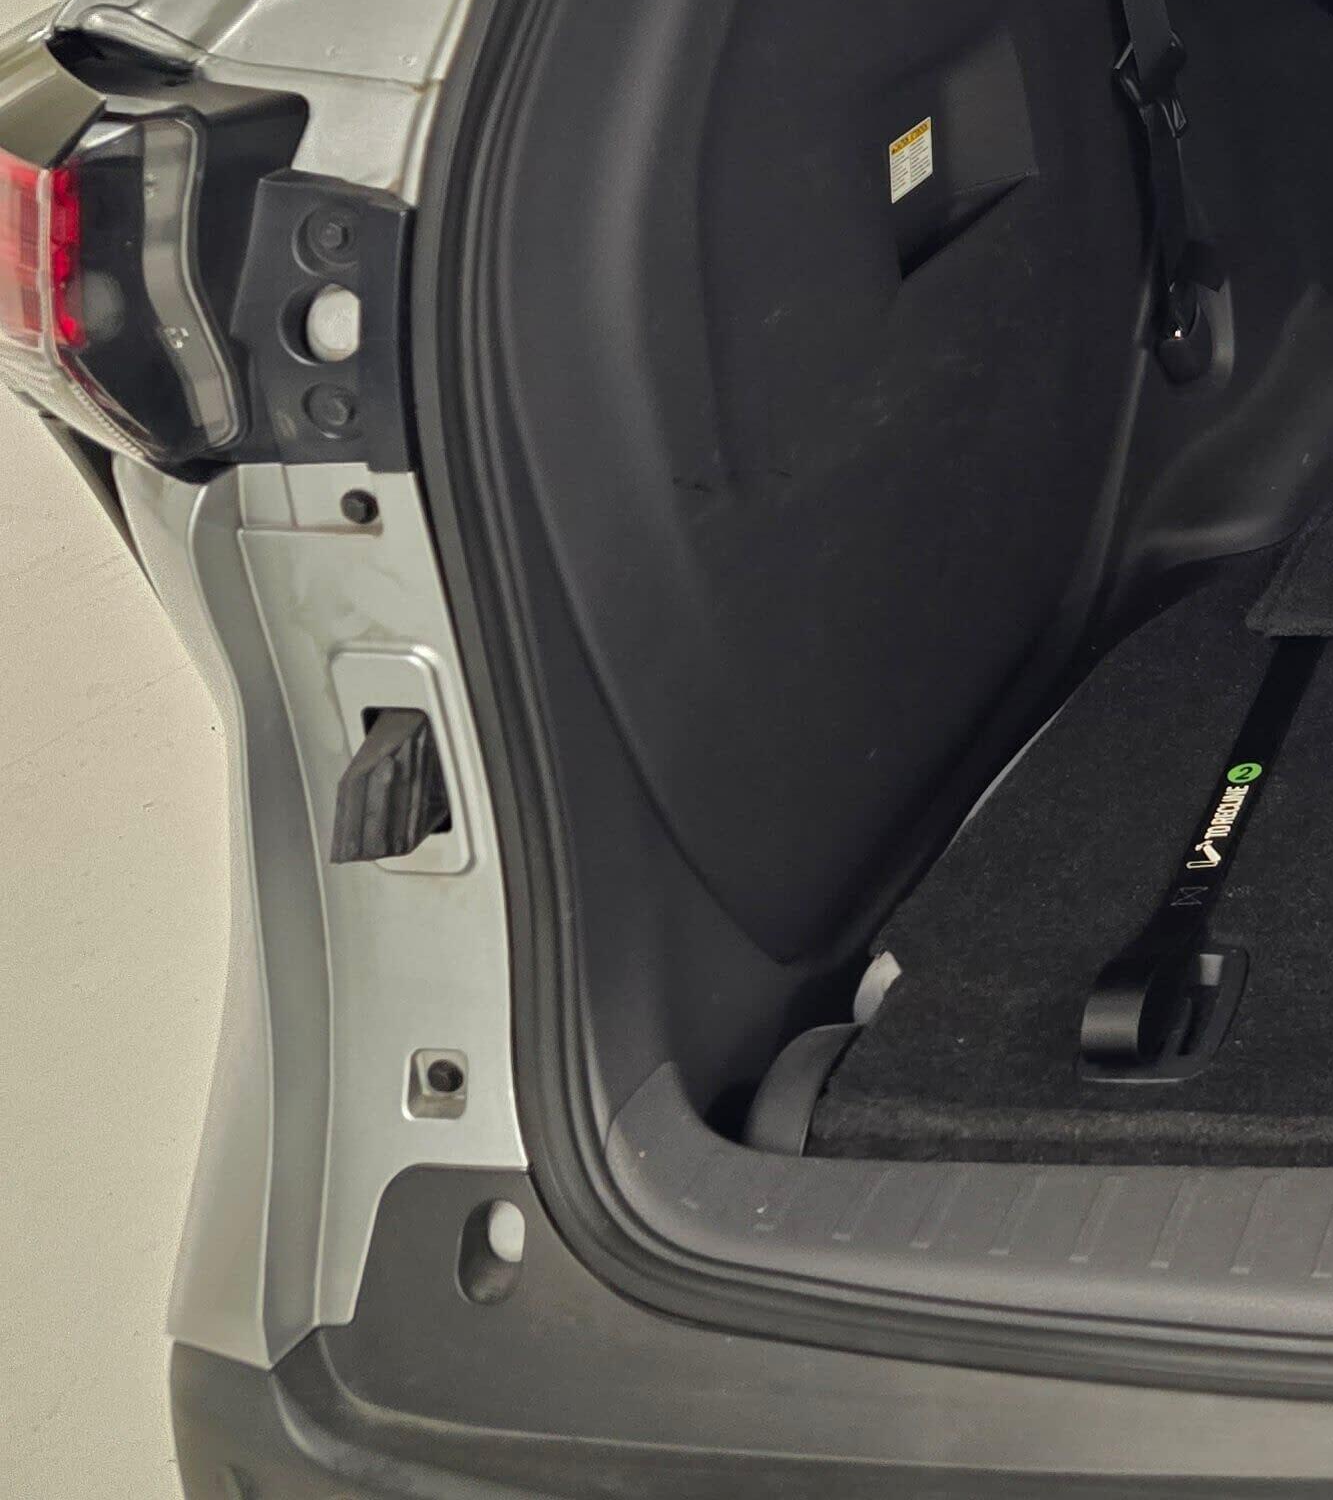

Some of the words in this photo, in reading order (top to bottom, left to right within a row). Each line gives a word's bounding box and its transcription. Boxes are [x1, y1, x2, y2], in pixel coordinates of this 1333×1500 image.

[1235, 766, 1253, 780] 2
[1210, 785, 1250, 826] RECLINE
[1204, 825, 1232, 840] TO
